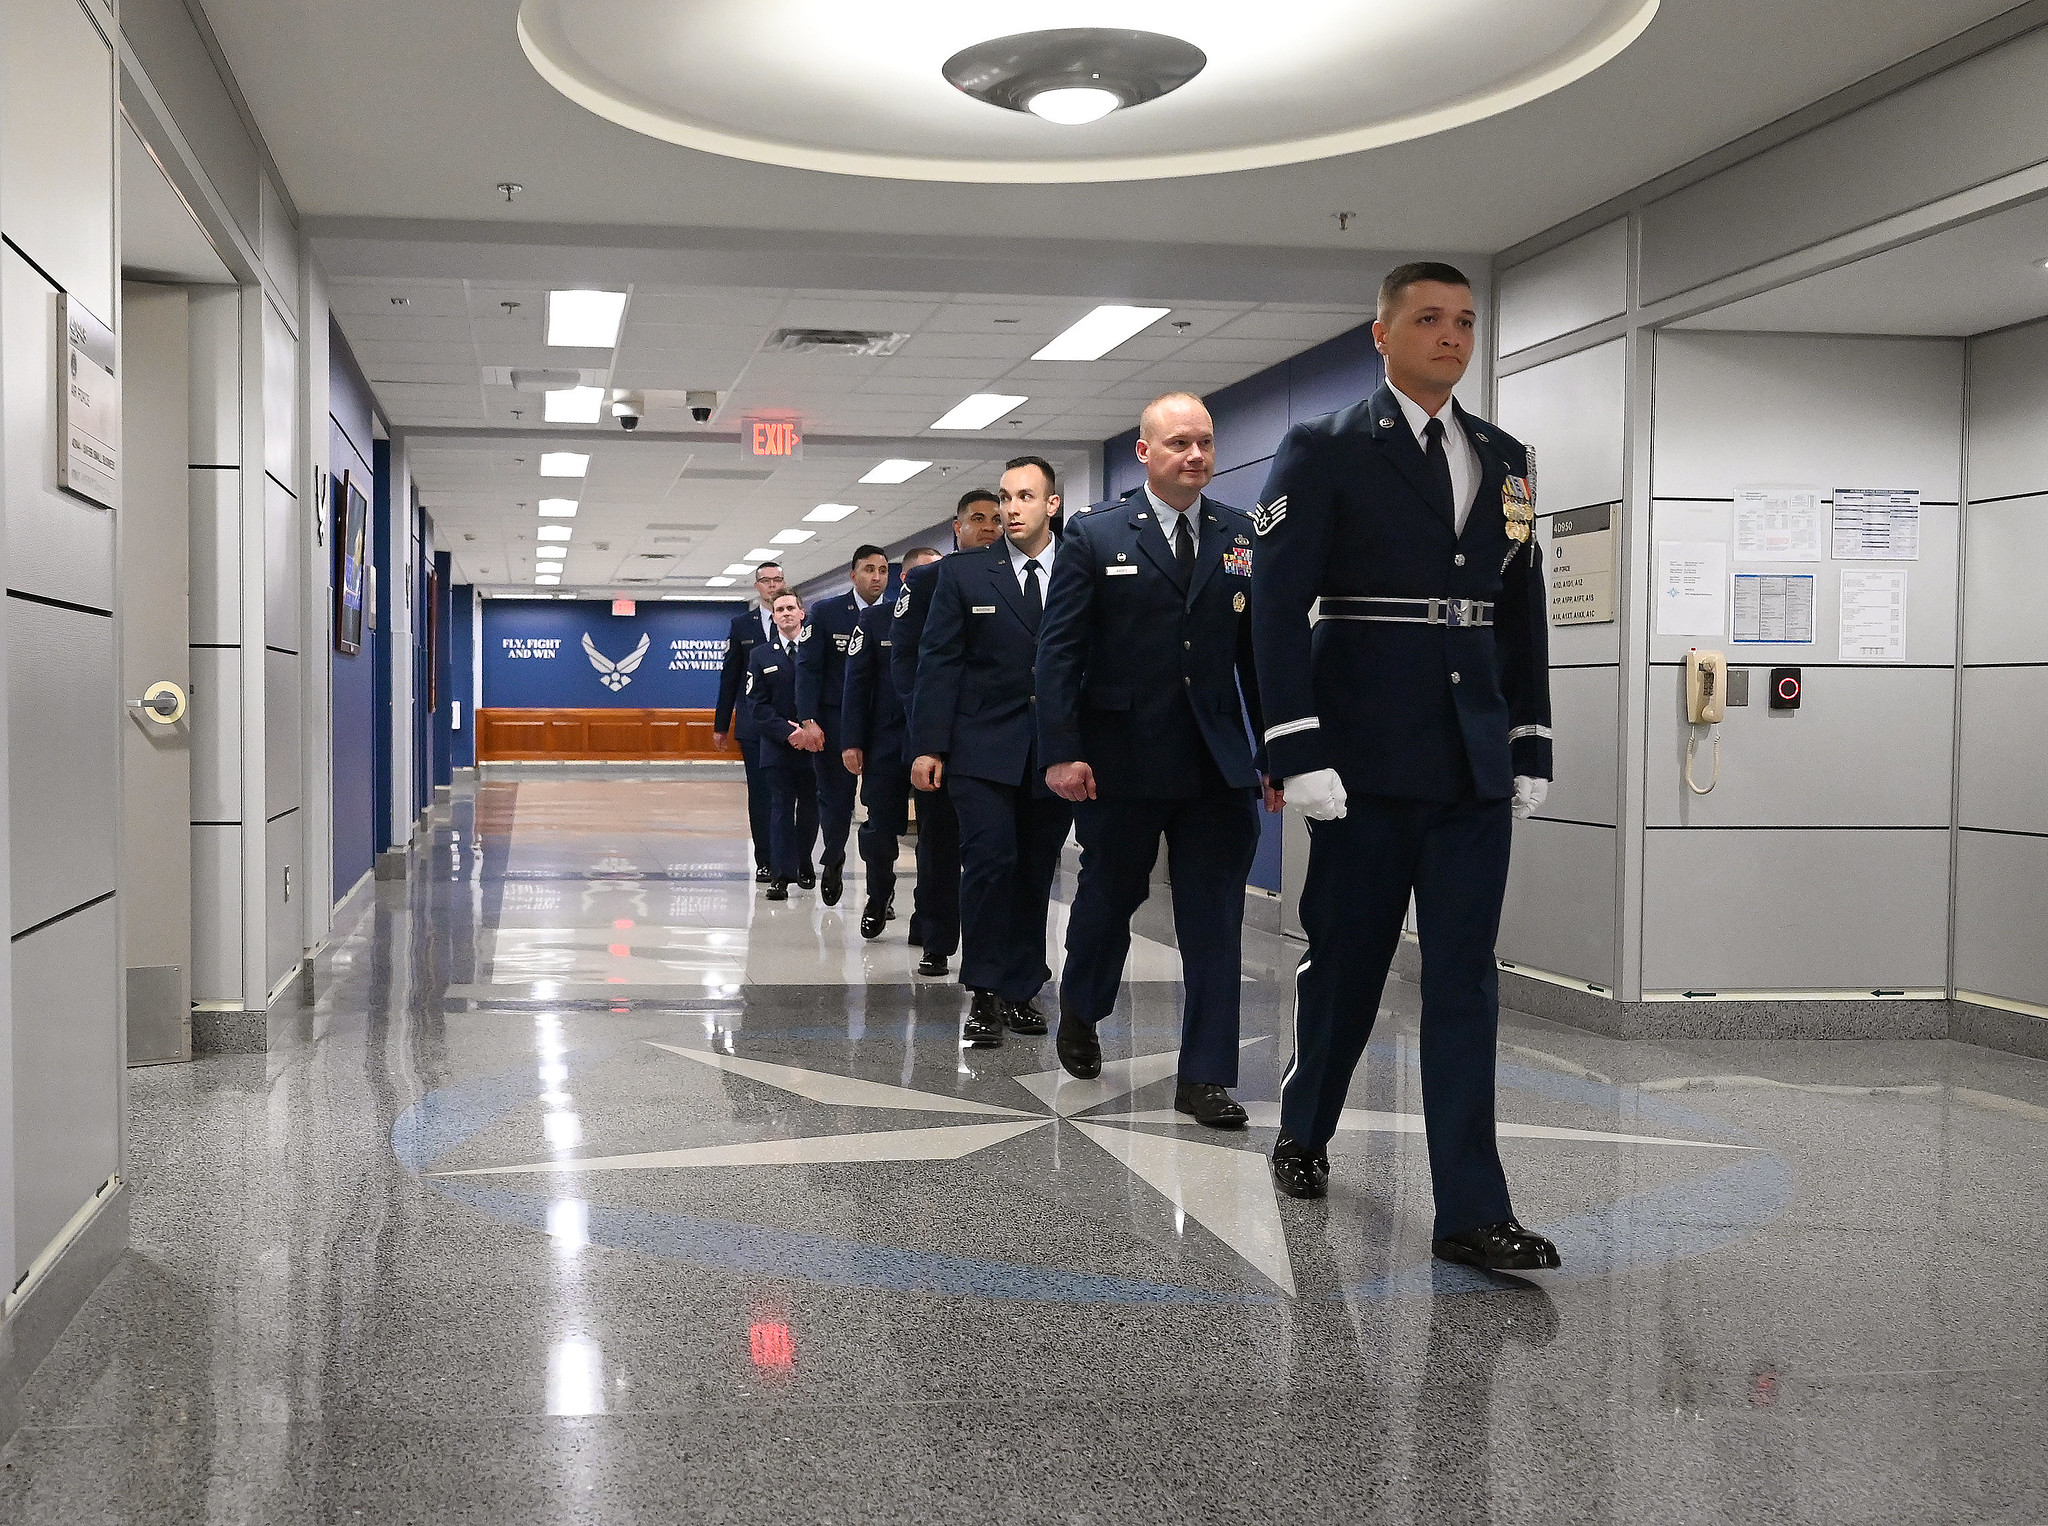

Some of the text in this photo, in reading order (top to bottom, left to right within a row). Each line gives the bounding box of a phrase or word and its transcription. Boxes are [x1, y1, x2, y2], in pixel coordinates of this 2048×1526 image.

[753, 423, 795, 456] EXIT
[502, 639, 562, 650] FLY, FIGHT
[508, 649, 556, 659] AND WIN
[674, 650, 725, 660] ANYTIME
[668, 661, 724, 670] ANYWHER
